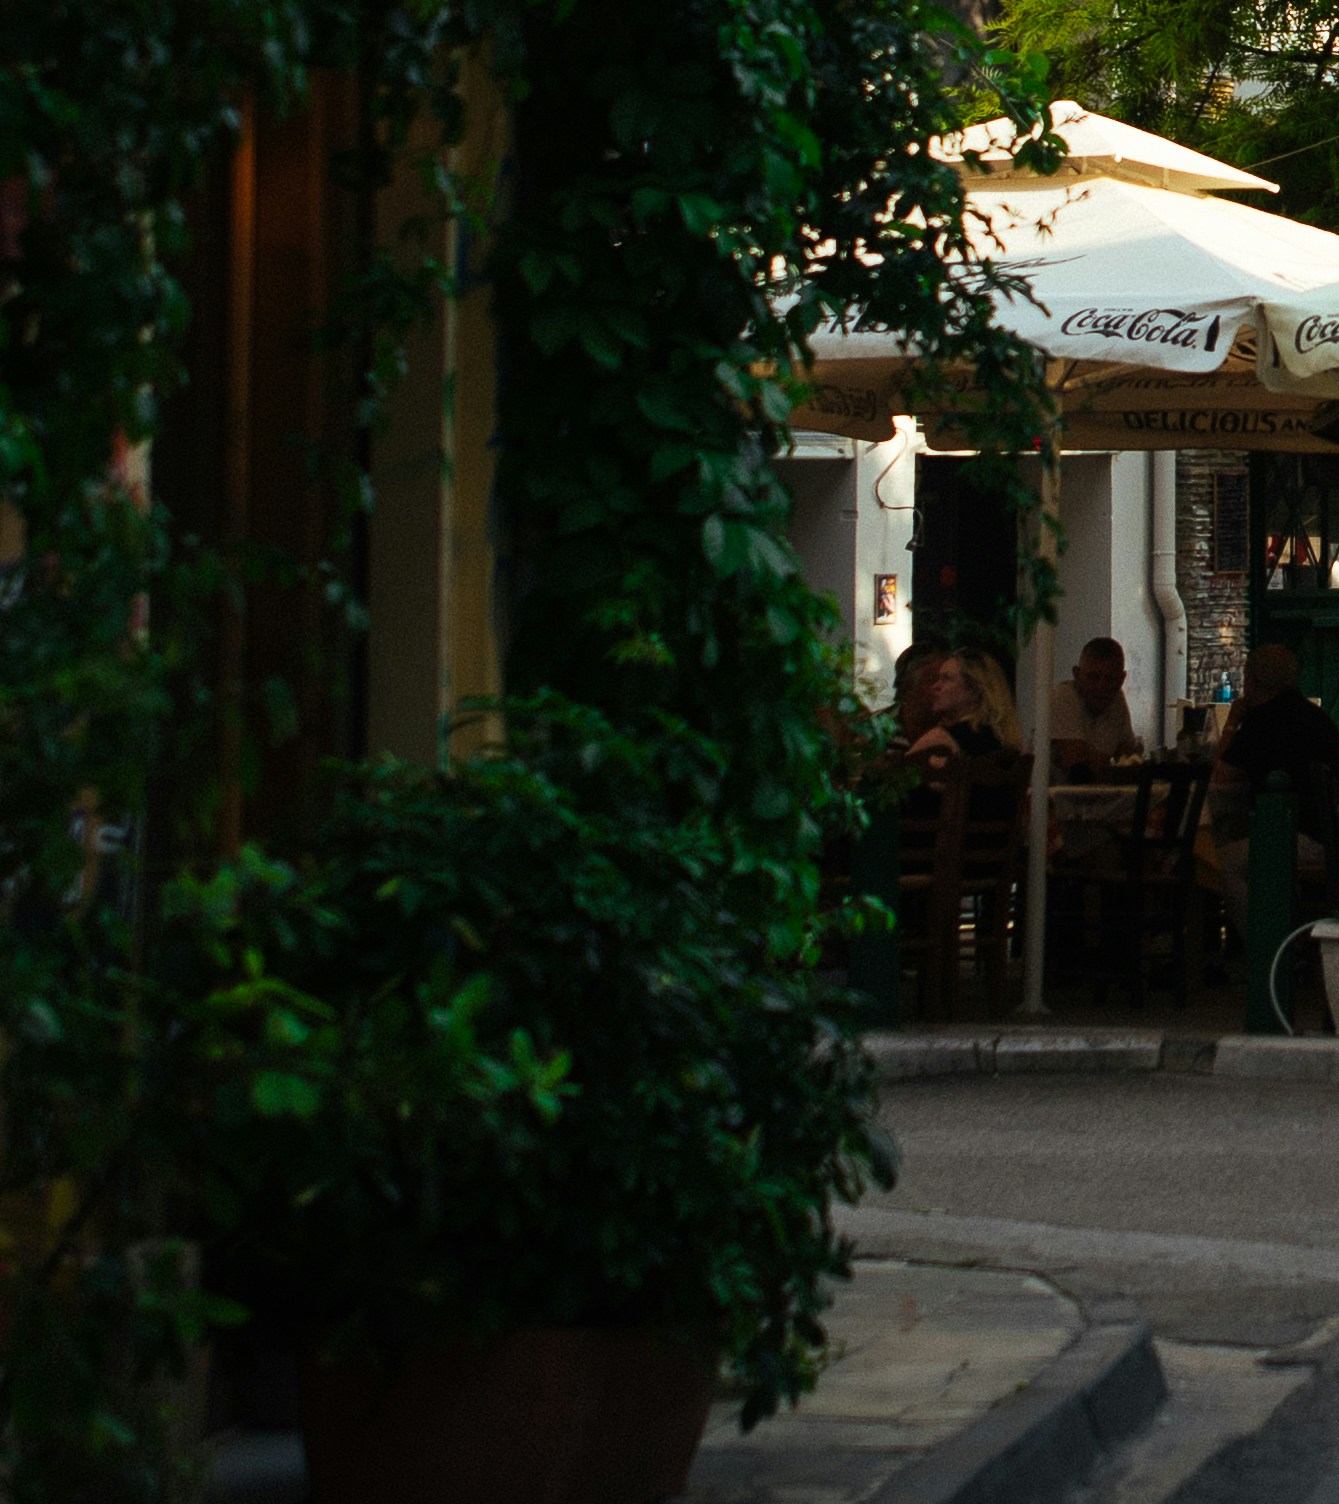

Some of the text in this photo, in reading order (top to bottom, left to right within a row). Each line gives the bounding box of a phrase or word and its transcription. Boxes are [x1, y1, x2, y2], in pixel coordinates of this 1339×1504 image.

[1061, 308, 1208, 349] Coca-Cola
[1122, 410, 1278, 436] DELICIOUS
[1281, 418, 1312, 432] AN
